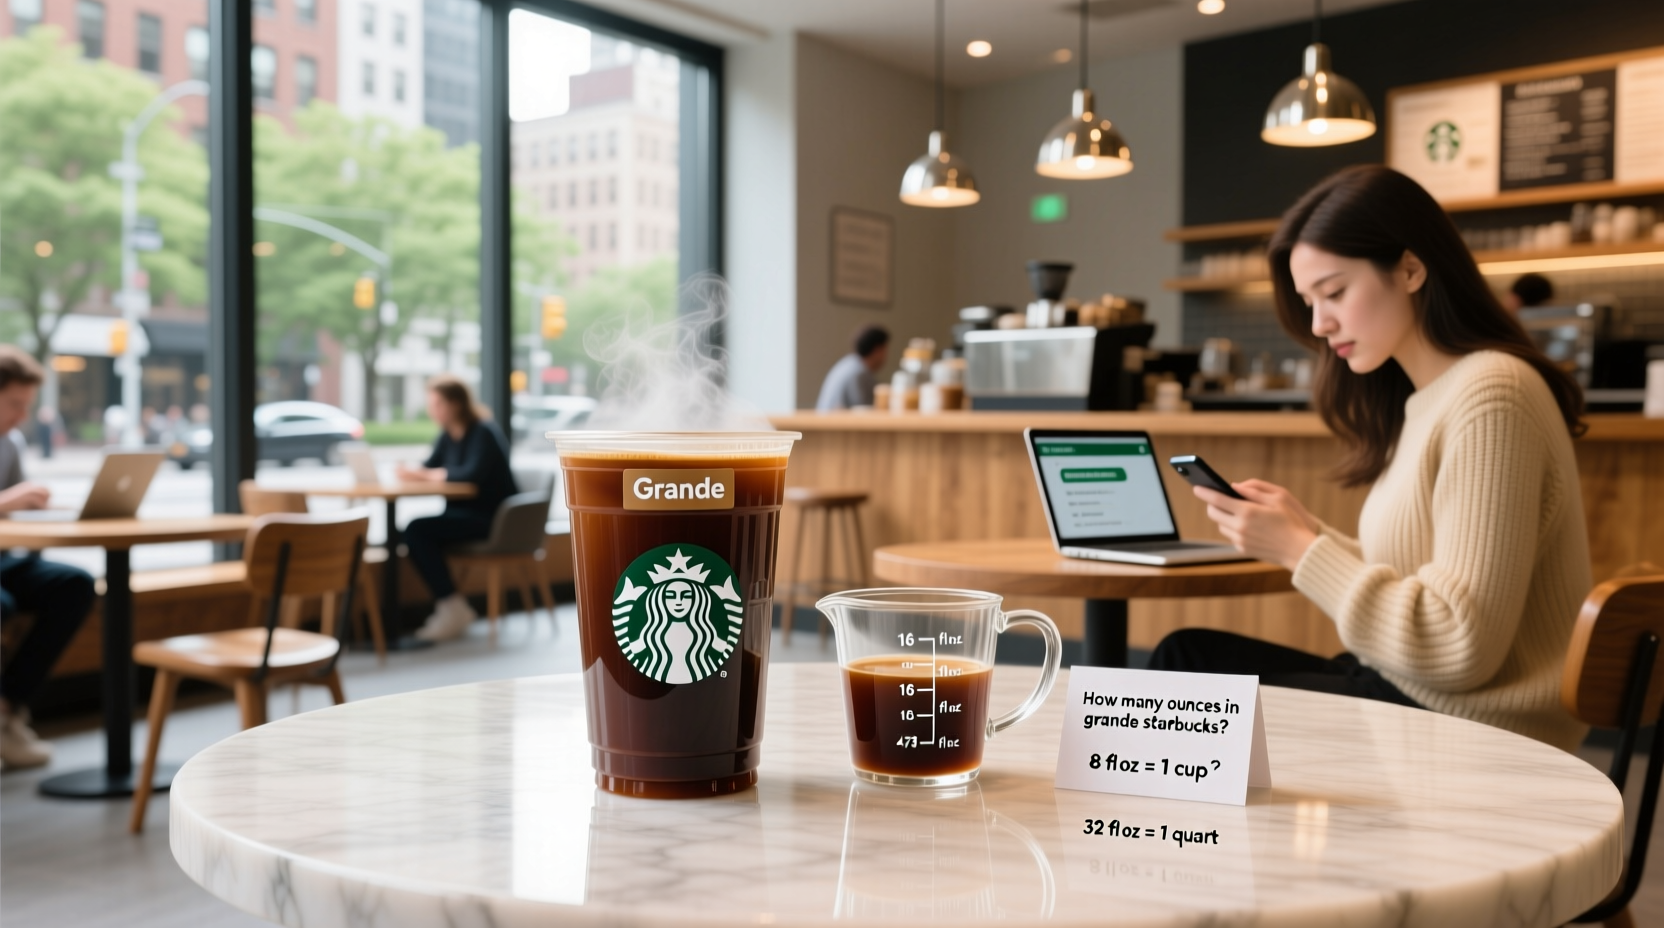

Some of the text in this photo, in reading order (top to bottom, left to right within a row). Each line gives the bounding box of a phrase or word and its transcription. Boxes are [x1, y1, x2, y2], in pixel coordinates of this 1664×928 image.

[633, 476, 725, 500] Grande
[898, 632, 915, 647] 16
[899, 683, 915, 696] 16
[1082, 691, 1240, 715] How many ounces in
[1083, 712, 1229, 735] grande starbucks?
[1088, 753, 1102, 770] 8
[1161, 758, 1169, 775] 1
[1082, 818, 1105, 836] 32
[1160, 824, 1168, 841] 1
[1172, 829, 1220, 849] quart
